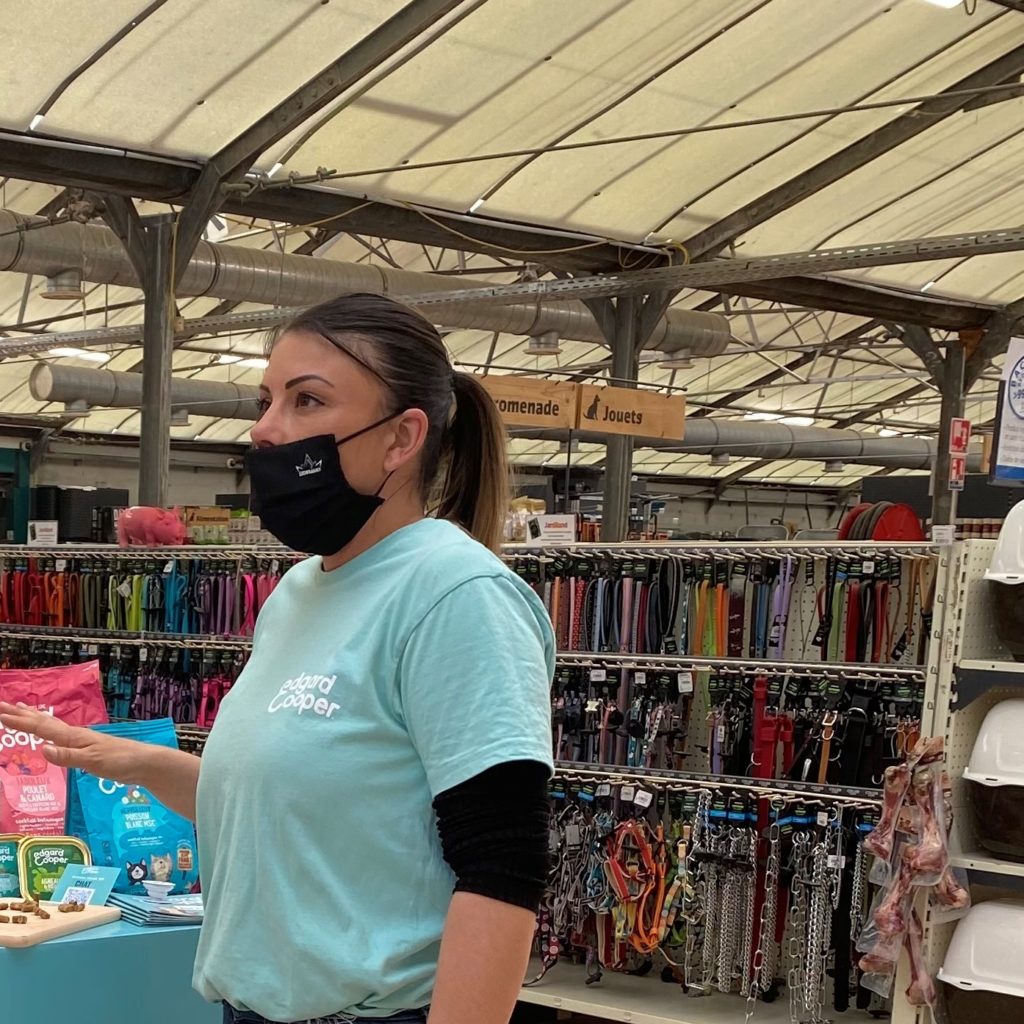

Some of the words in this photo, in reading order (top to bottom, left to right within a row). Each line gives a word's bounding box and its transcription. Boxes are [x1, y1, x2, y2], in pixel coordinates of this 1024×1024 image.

[495, 399, 559, 416] omenade
[603, 405, 643, 425] Jouets
[280, 672, 337, 695] edgard
[267, 690, 341, 718] Cooper
[23, 785, 48, 794] POULET
[27, 793, 55, 802] CANARD
[33, 849, 64, 860] edgard
[34, 856, 69, 866] Cooper
